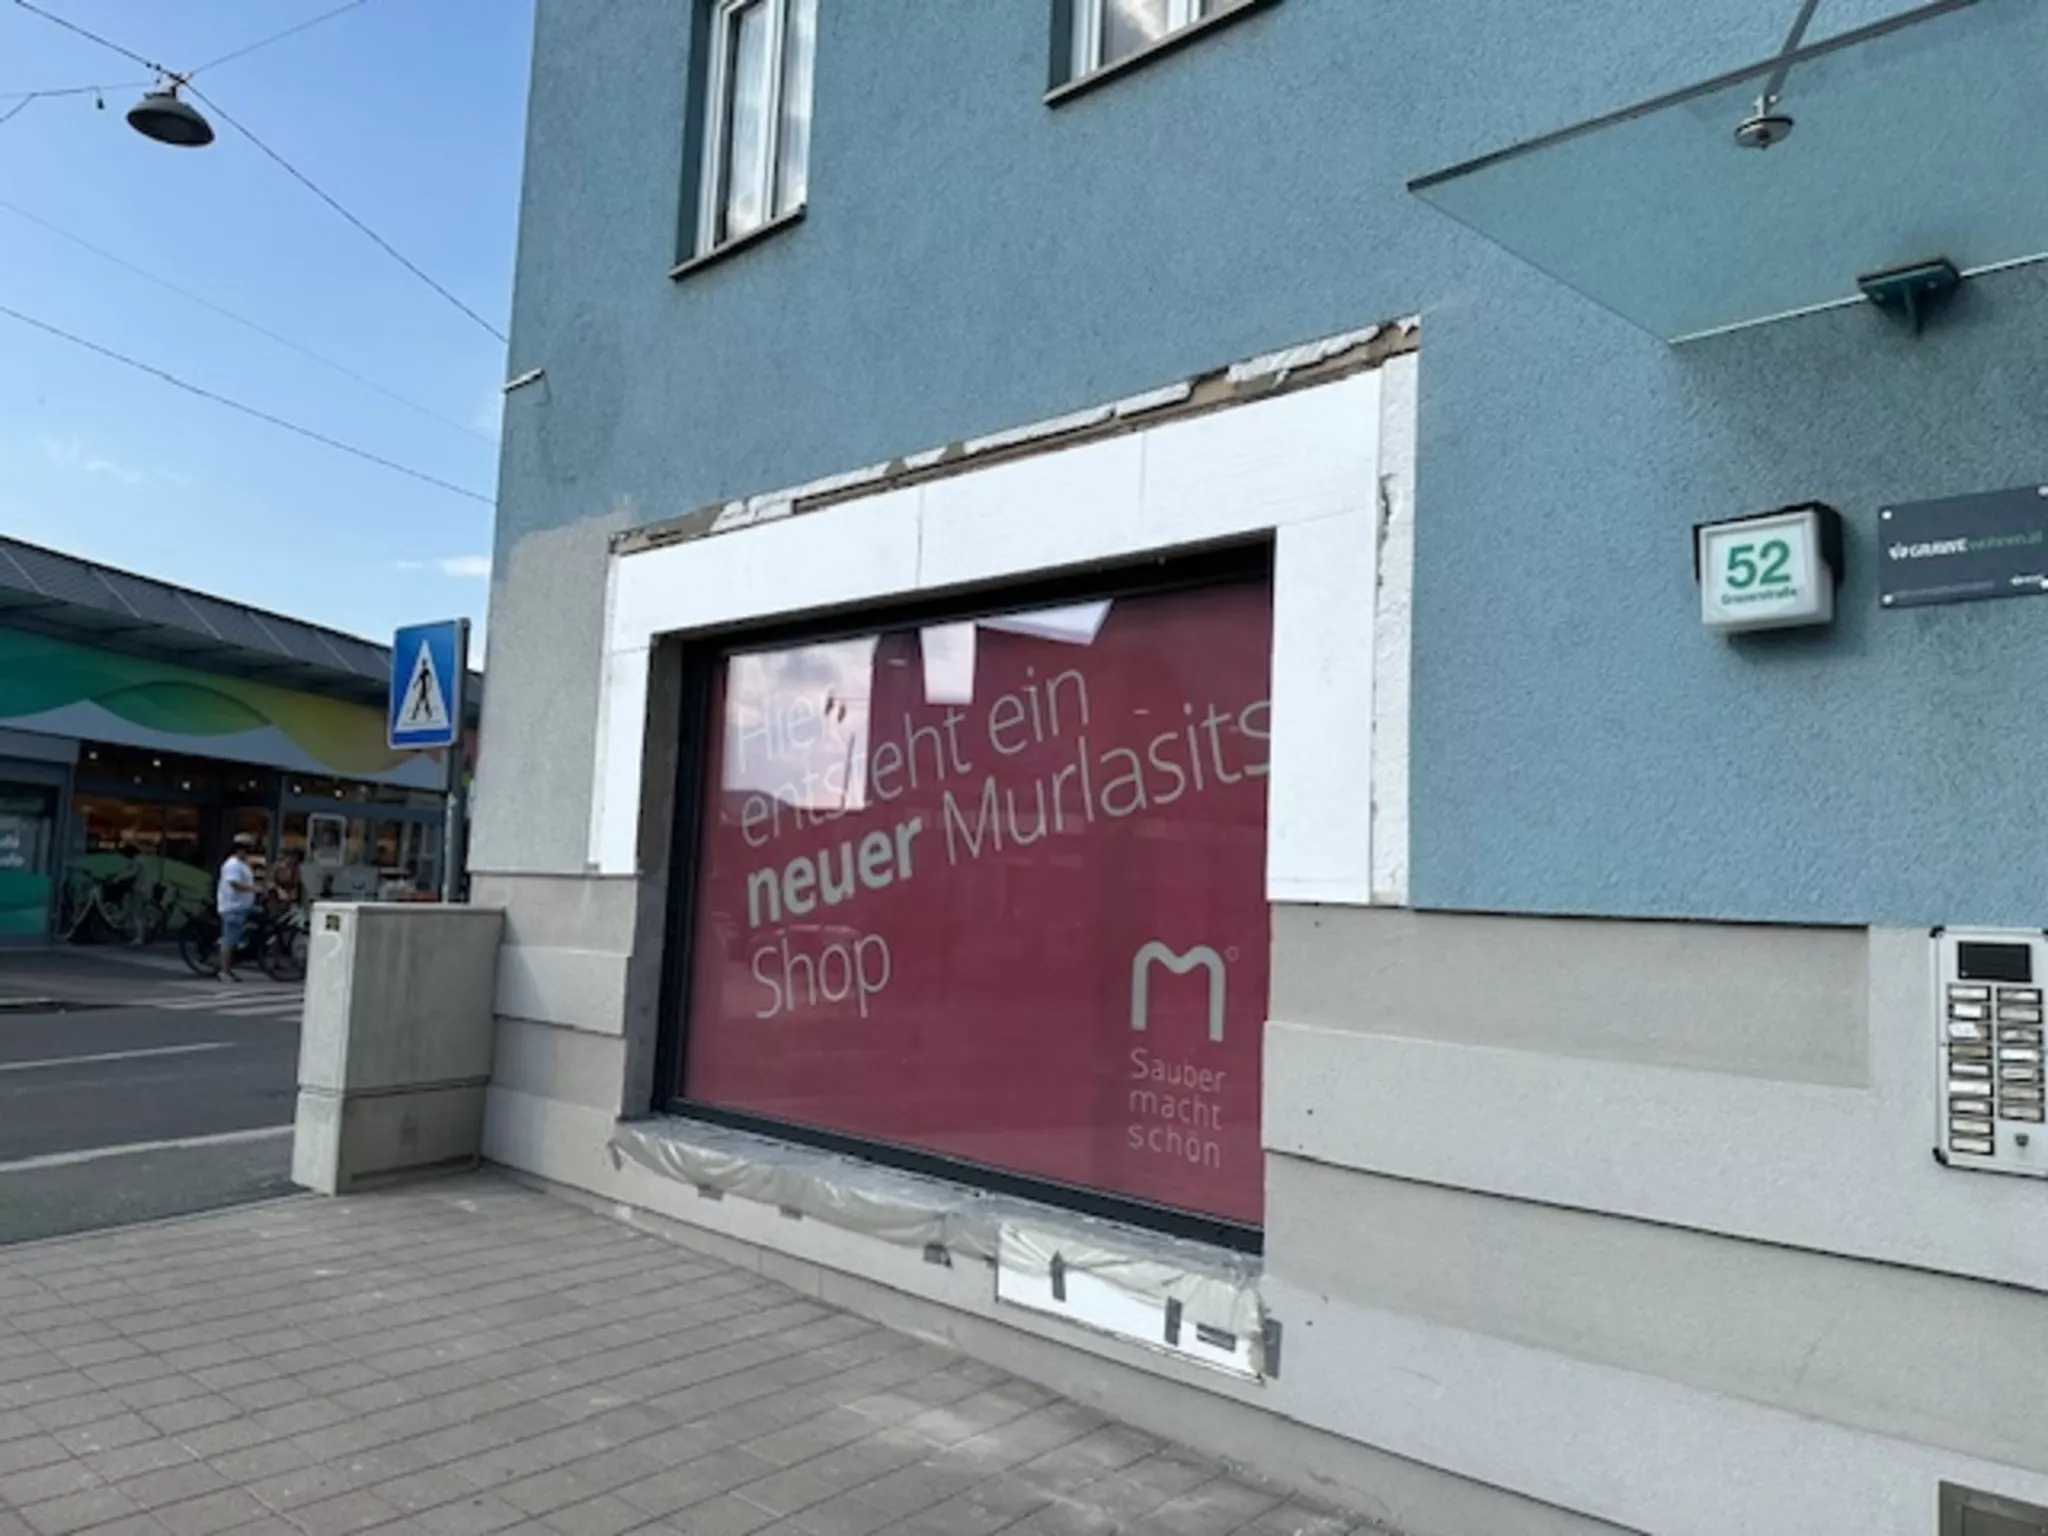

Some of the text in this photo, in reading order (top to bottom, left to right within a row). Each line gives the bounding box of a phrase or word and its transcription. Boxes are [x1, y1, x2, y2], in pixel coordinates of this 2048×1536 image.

[1726, 539, 1792, 589] 52
[737, 684, 836, 774] Hier
[741, 665, 1090, 848] entsteht ein
[748, 699, 1271, 929] neuer Murlasits
[752, 933, 891, 1019] Shop
[1129, 1046, 1228, 1093] Sauber
[1129, 1088, 1223, 1131] macht
[1127, 1122, 1221, 1170] schön
